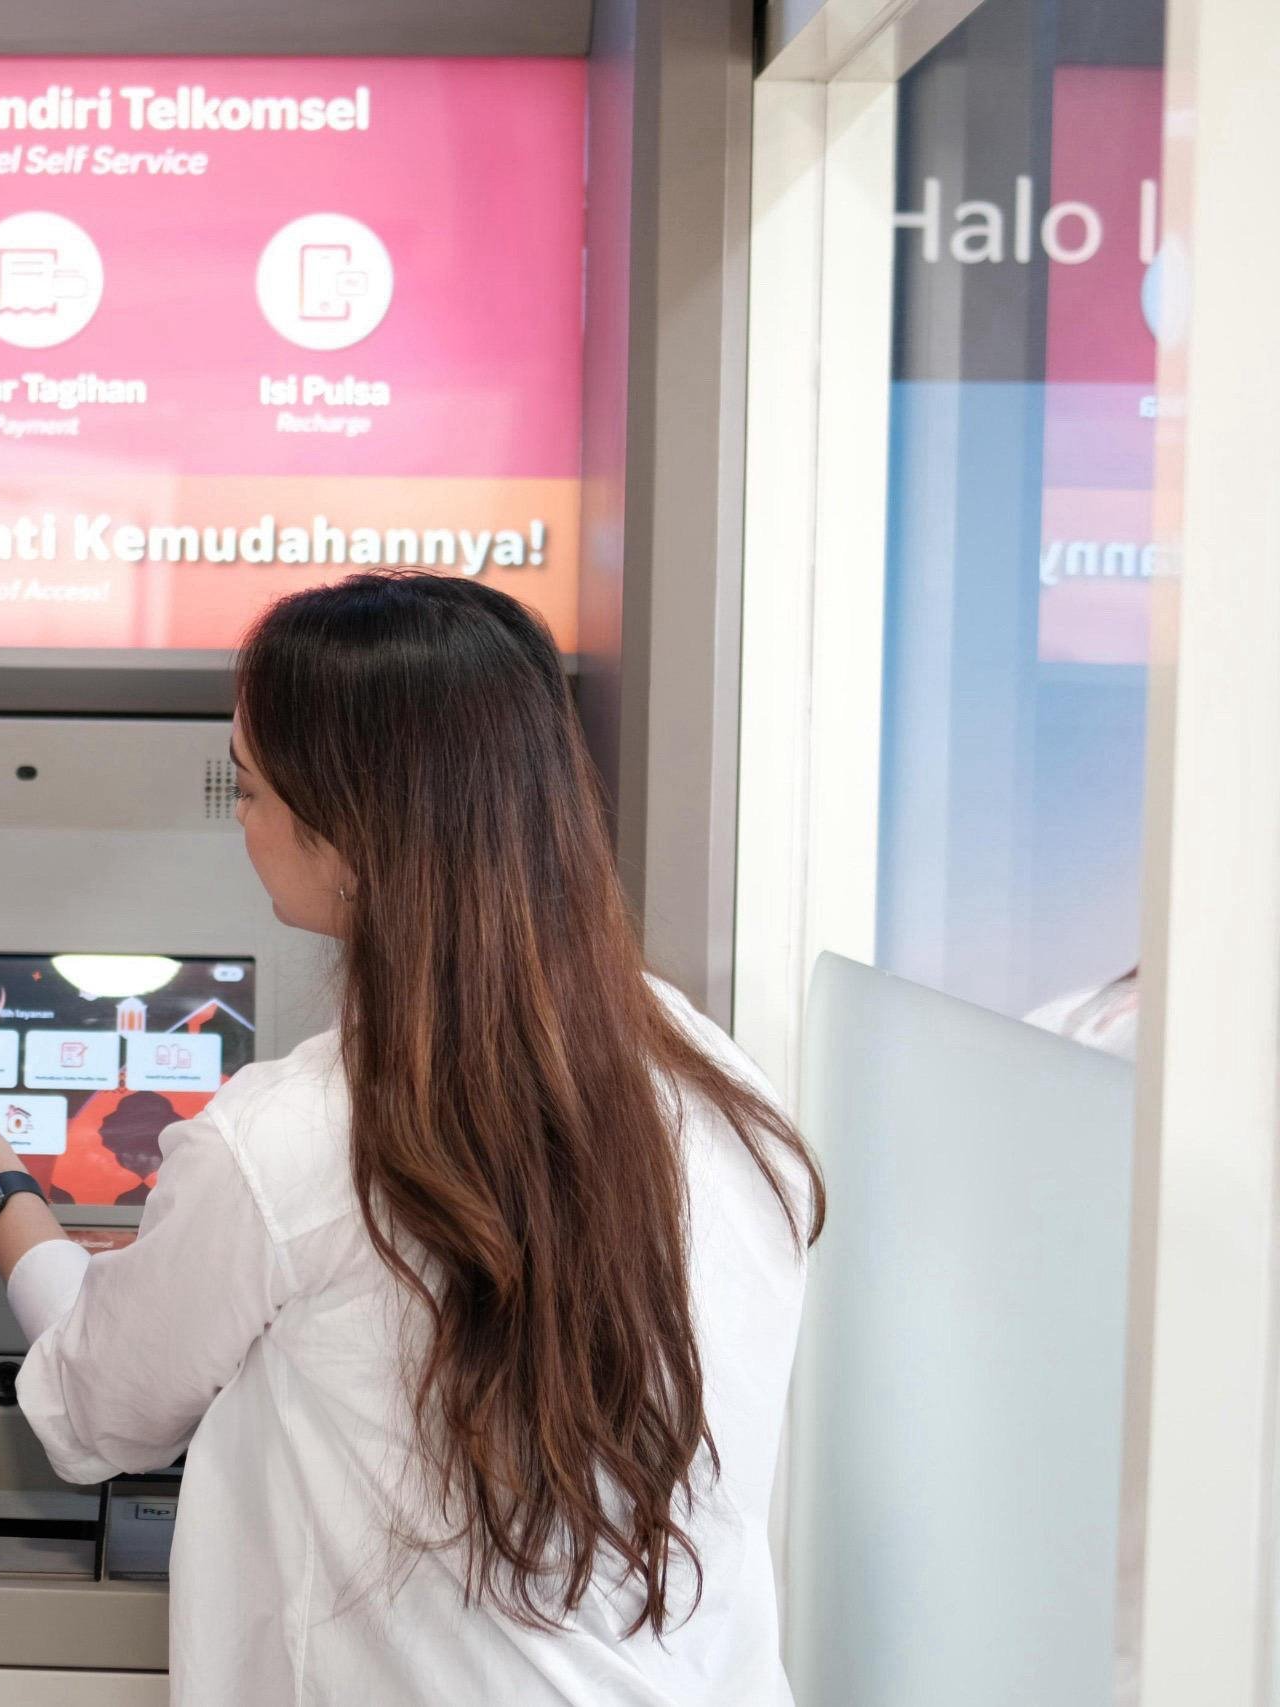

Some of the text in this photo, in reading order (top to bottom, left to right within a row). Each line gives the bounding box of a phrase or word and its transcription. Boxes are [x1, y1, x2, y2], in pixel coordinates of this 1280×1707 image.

[120, 86, 369, 131] Telkomsel
[25, 146, 89, 175] Self
[91, 146, 208, 175] Service
[892, 176, 1104, 264] Halo
[22, 373, 146, 409] Tagihan
[260, 375, 390, 406] Isi Pulsa
[276, 412, 371, 436] Recharge
[73, 515, 546, 575] Kemudahannya!
